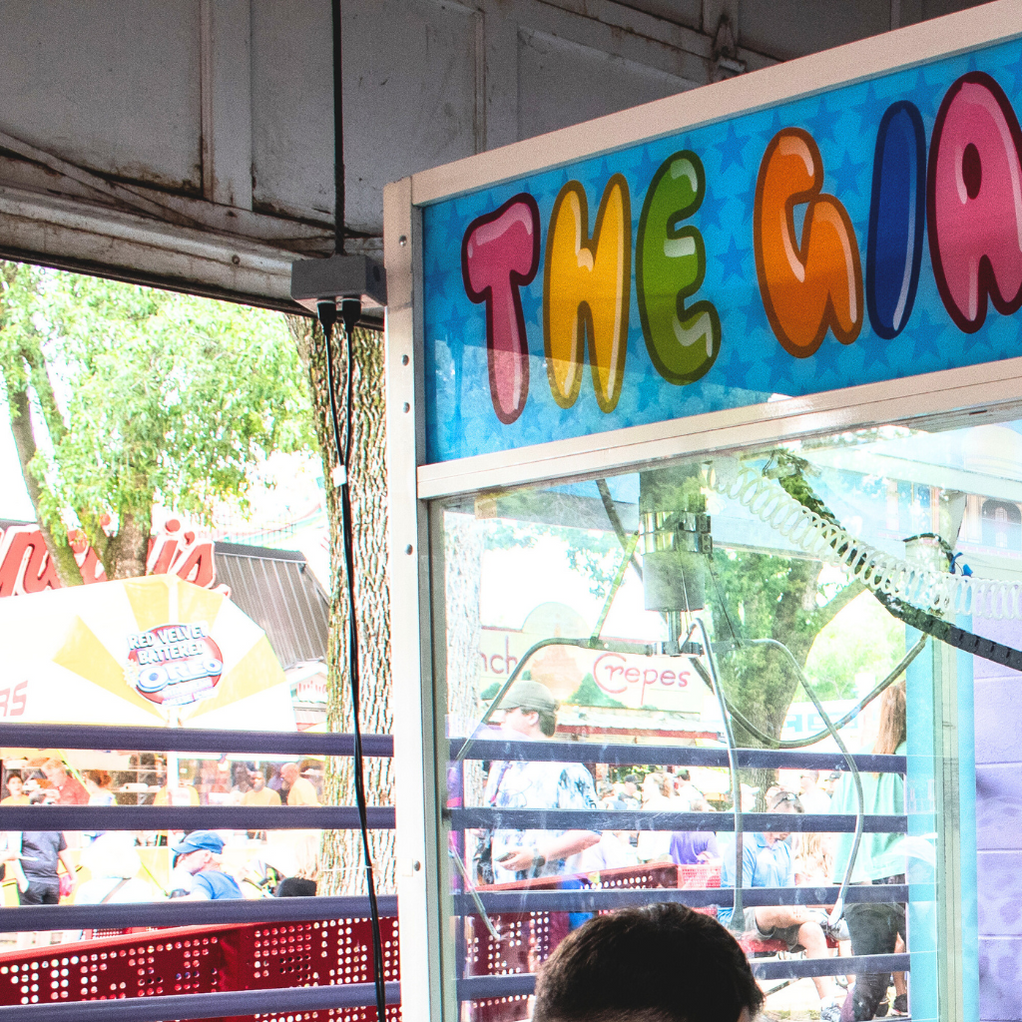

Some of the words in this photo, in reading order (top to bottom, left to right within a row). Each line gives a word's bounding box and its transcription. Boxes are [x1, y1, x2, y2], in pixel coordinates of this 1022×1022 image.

[461, 150, 721, 425] THE
[127, 634, 155, 650] RED
[136, 641, 205, 666] BATTERED
[137, 658, 223, 692] OREO
[593, 652, 691, 706] Crepes
